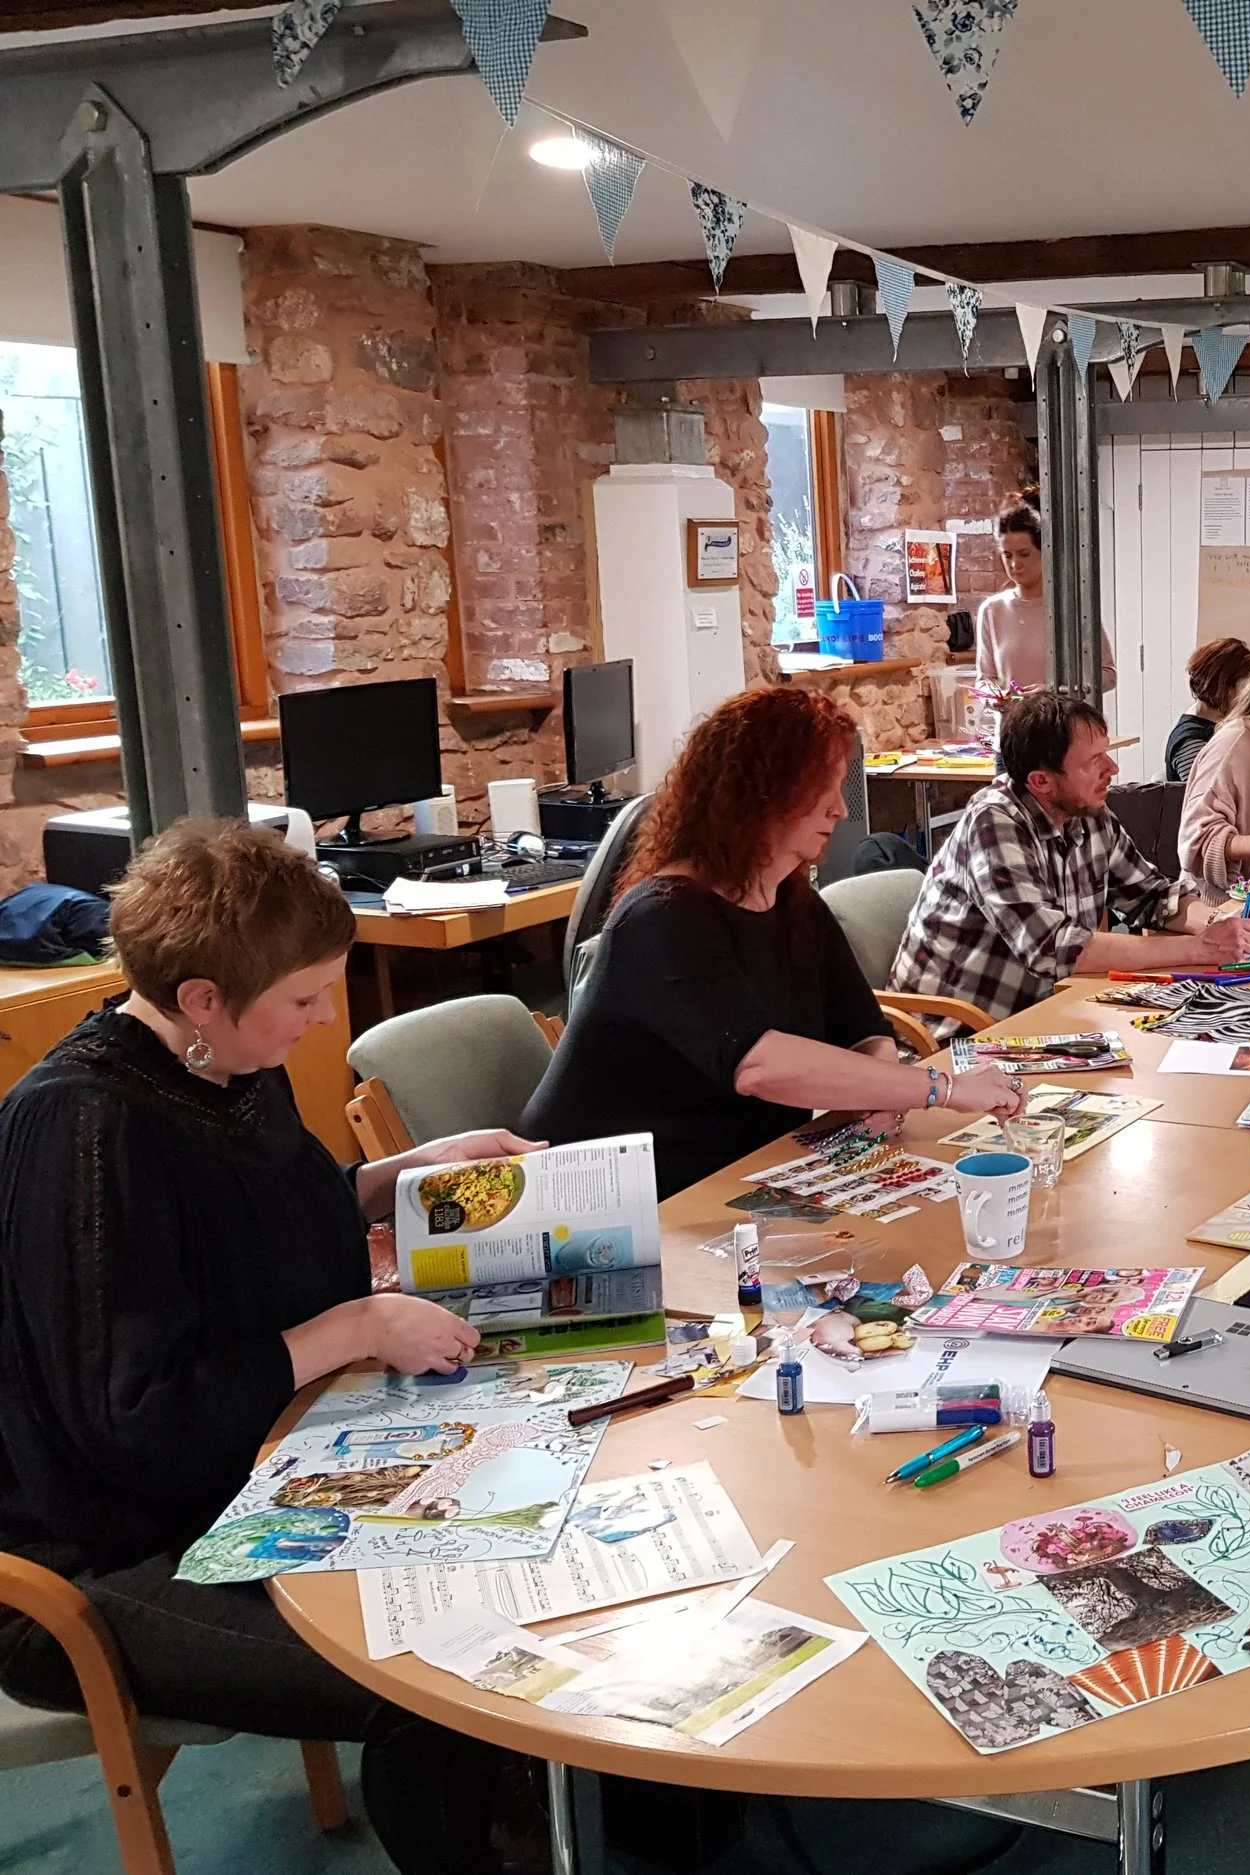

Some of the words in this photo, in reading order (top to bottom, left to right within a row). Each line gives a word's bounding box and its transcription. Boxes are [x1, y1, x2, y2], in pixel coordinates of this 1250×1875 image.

[936, 1350, 958, 1371] EHP
[1132, 1493, 1155, 1502] FEEL
[1155, 1487, 1177, 1497] LIKE
